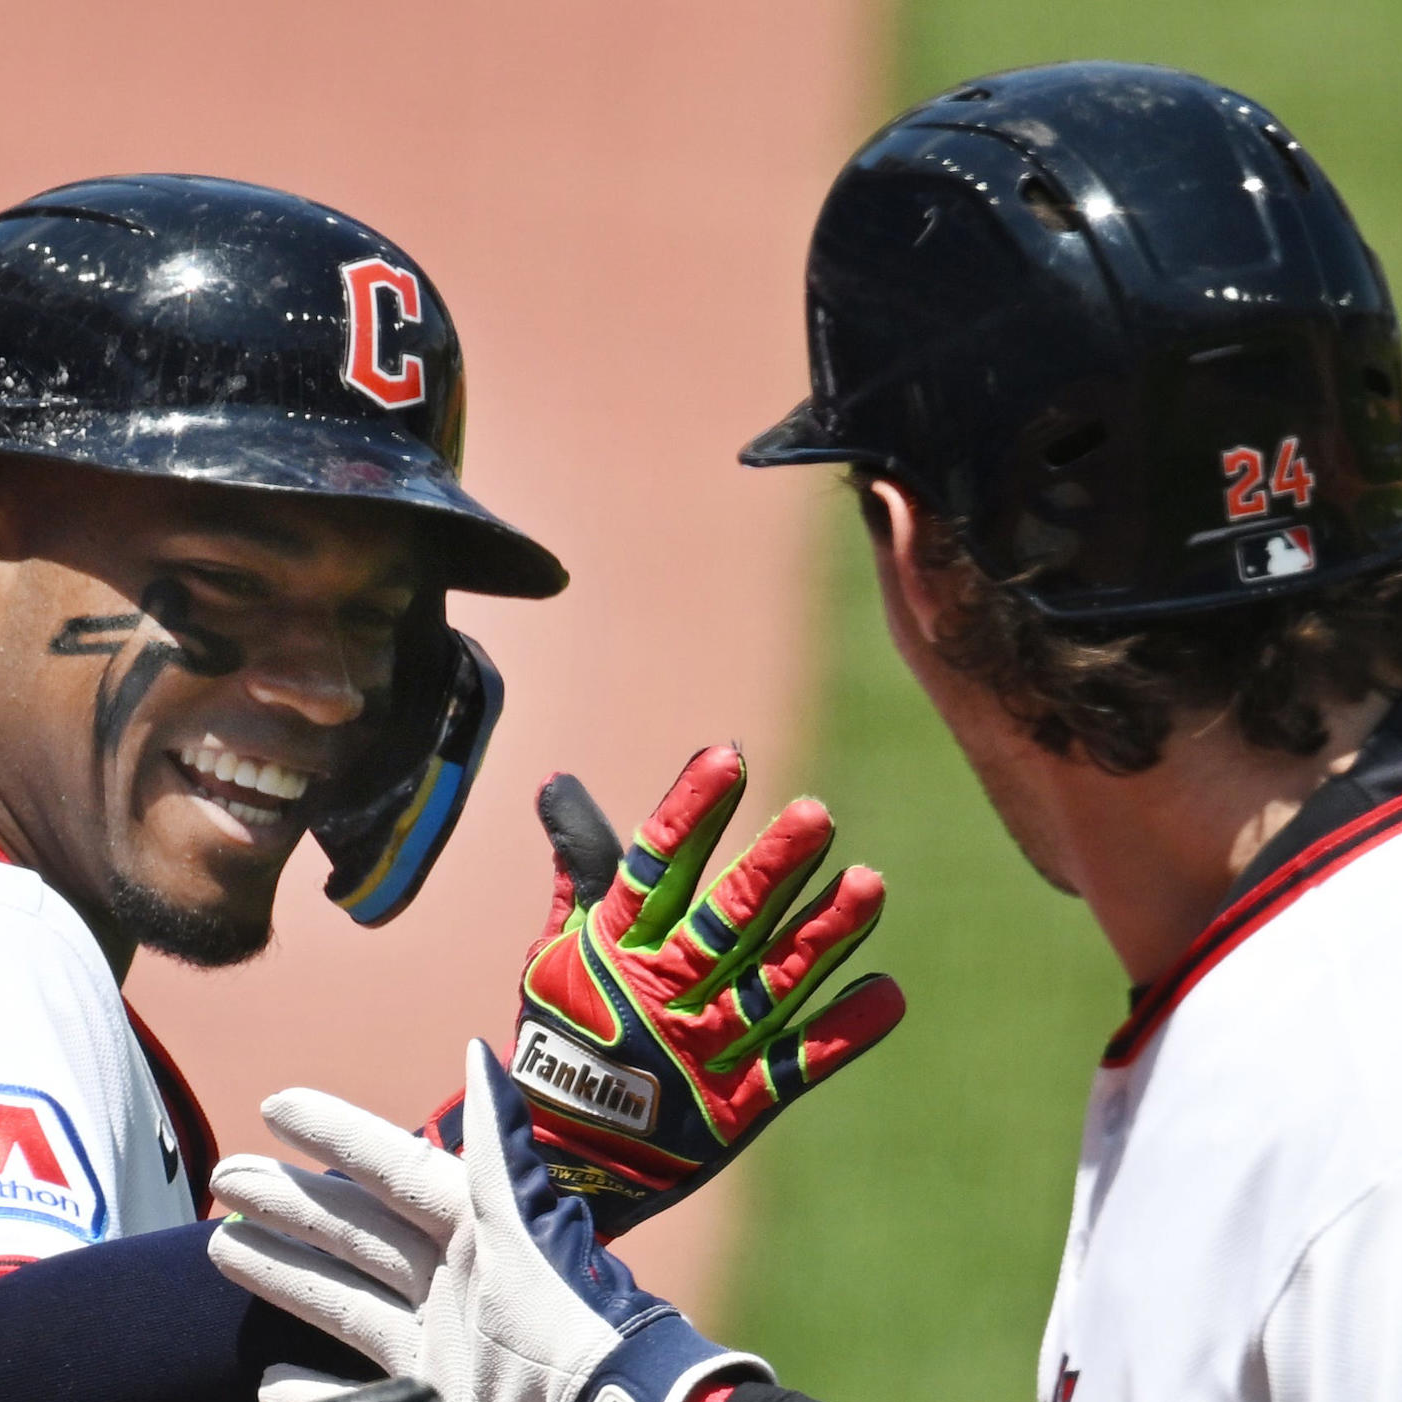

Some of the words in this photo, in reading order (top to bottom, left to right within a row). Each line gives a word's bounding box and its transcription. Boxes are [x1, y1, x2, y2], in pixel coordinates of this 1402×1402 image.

[341, 257, 426, 410] C
[1221, 435, 1315, 521] 24
[547, 1166, 647, 1199] OWERSTRAP
